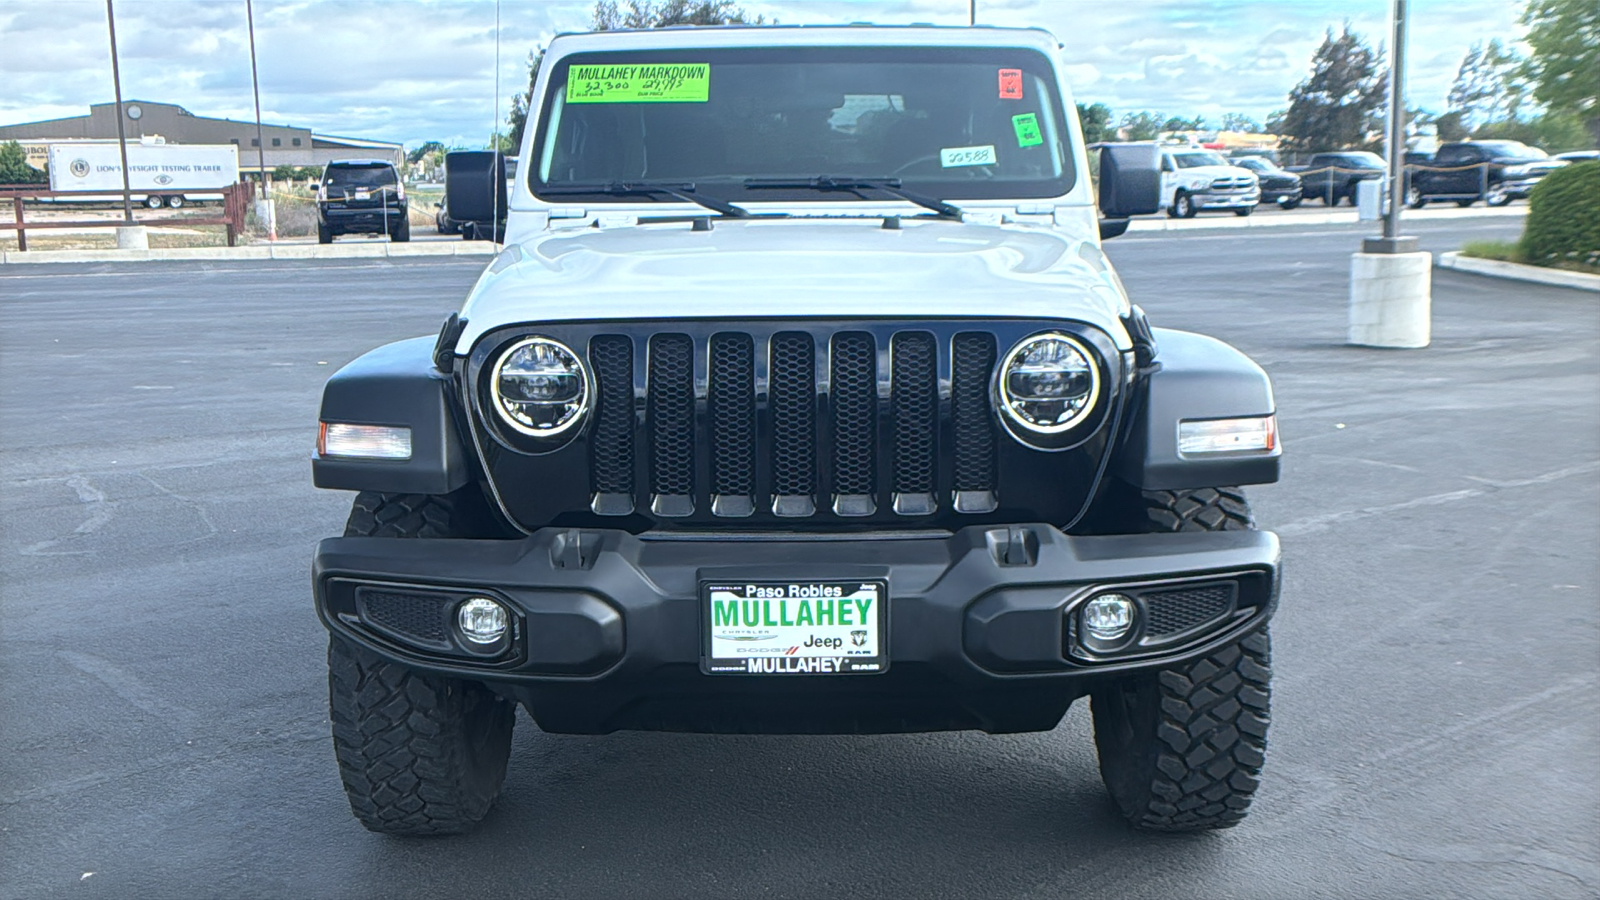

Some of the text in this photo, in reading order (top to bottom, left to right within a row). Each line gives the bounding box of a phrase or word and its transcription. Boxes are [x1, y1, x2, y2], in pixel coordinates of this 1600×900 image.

[577, 66, 706, 80] MULLAHEY MARKDOWN
[745, 584, 842, 598] Paso Robles
[714, 599, 873, 627] MULLAHEY
[803, 634, 843, 650] Jeep
[747, 657, 843, 673] MULLAHEY
